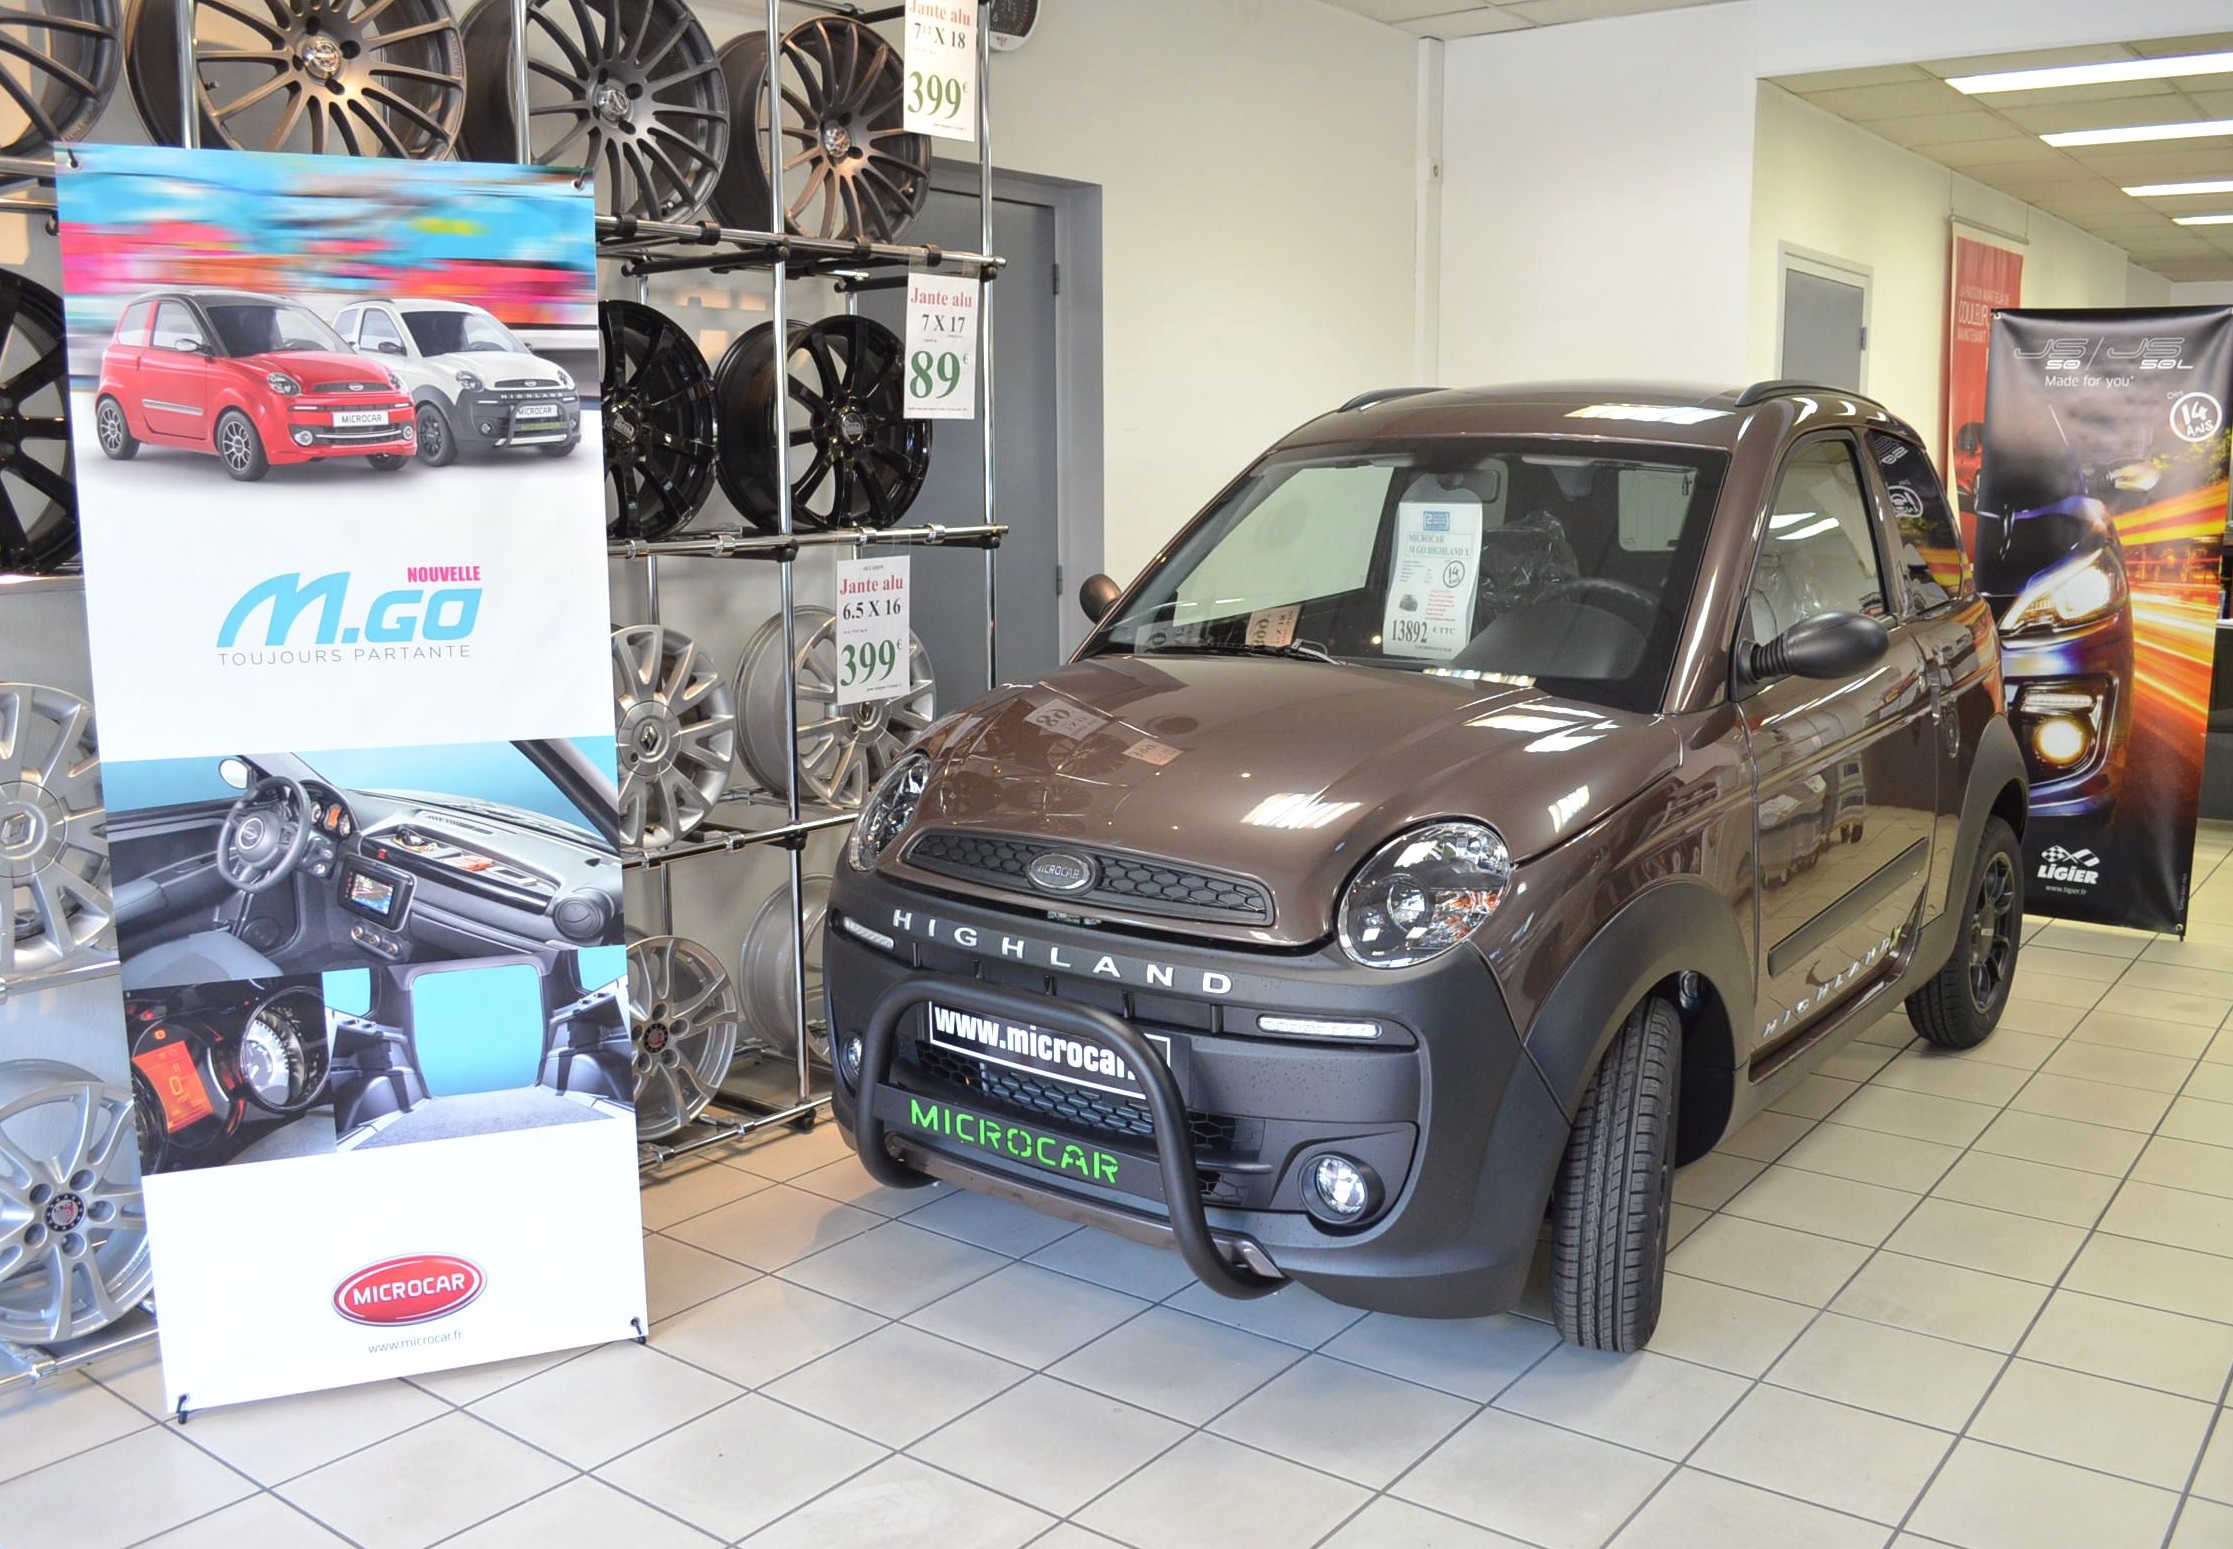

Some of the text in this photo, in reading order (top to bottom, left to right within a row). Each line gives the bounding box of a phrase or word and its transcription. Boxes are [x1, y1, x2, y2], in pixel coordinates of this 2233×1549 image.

[909, 0, 971, 26] Jante alu
[934, 27, 945, 45] X
[951, 31, 966, 49] 18
[911, 287, 972, 307] Jante alu
[922, 314, 965, 333] 7 X 17
[2045, 375, 2079, 388] Made
[2083, 375, 2101, 387] for
[341, 414, 382, 424] MICROCAR
[2180, 401, 2208, 425] 14
[2185, 419, 2214, 438] ANS
[407, 566, 481, 583] NOUVELLE
[840, 575, 903, 595] Jante alu
[216, 571, 483, 648] M.GO
[843, 598, 901, 621] 6.5 X 16
[1391, 620, 1428, 643] 13892
[218, 645, 471, 666] TOUJOURS PARTANTE
[1037, 864, 1079, 880] MICROCAR
[2045, 884, 2088, 896] www.ligier.fr
[892, 908, 1234, 995] HIGHLAND
[908, 1098, 1119, 1185] MICROCAR
[353, 1273, 465, 1306] MICROCAR
[368, 1329, 462, 1354] www.microcar.fr
